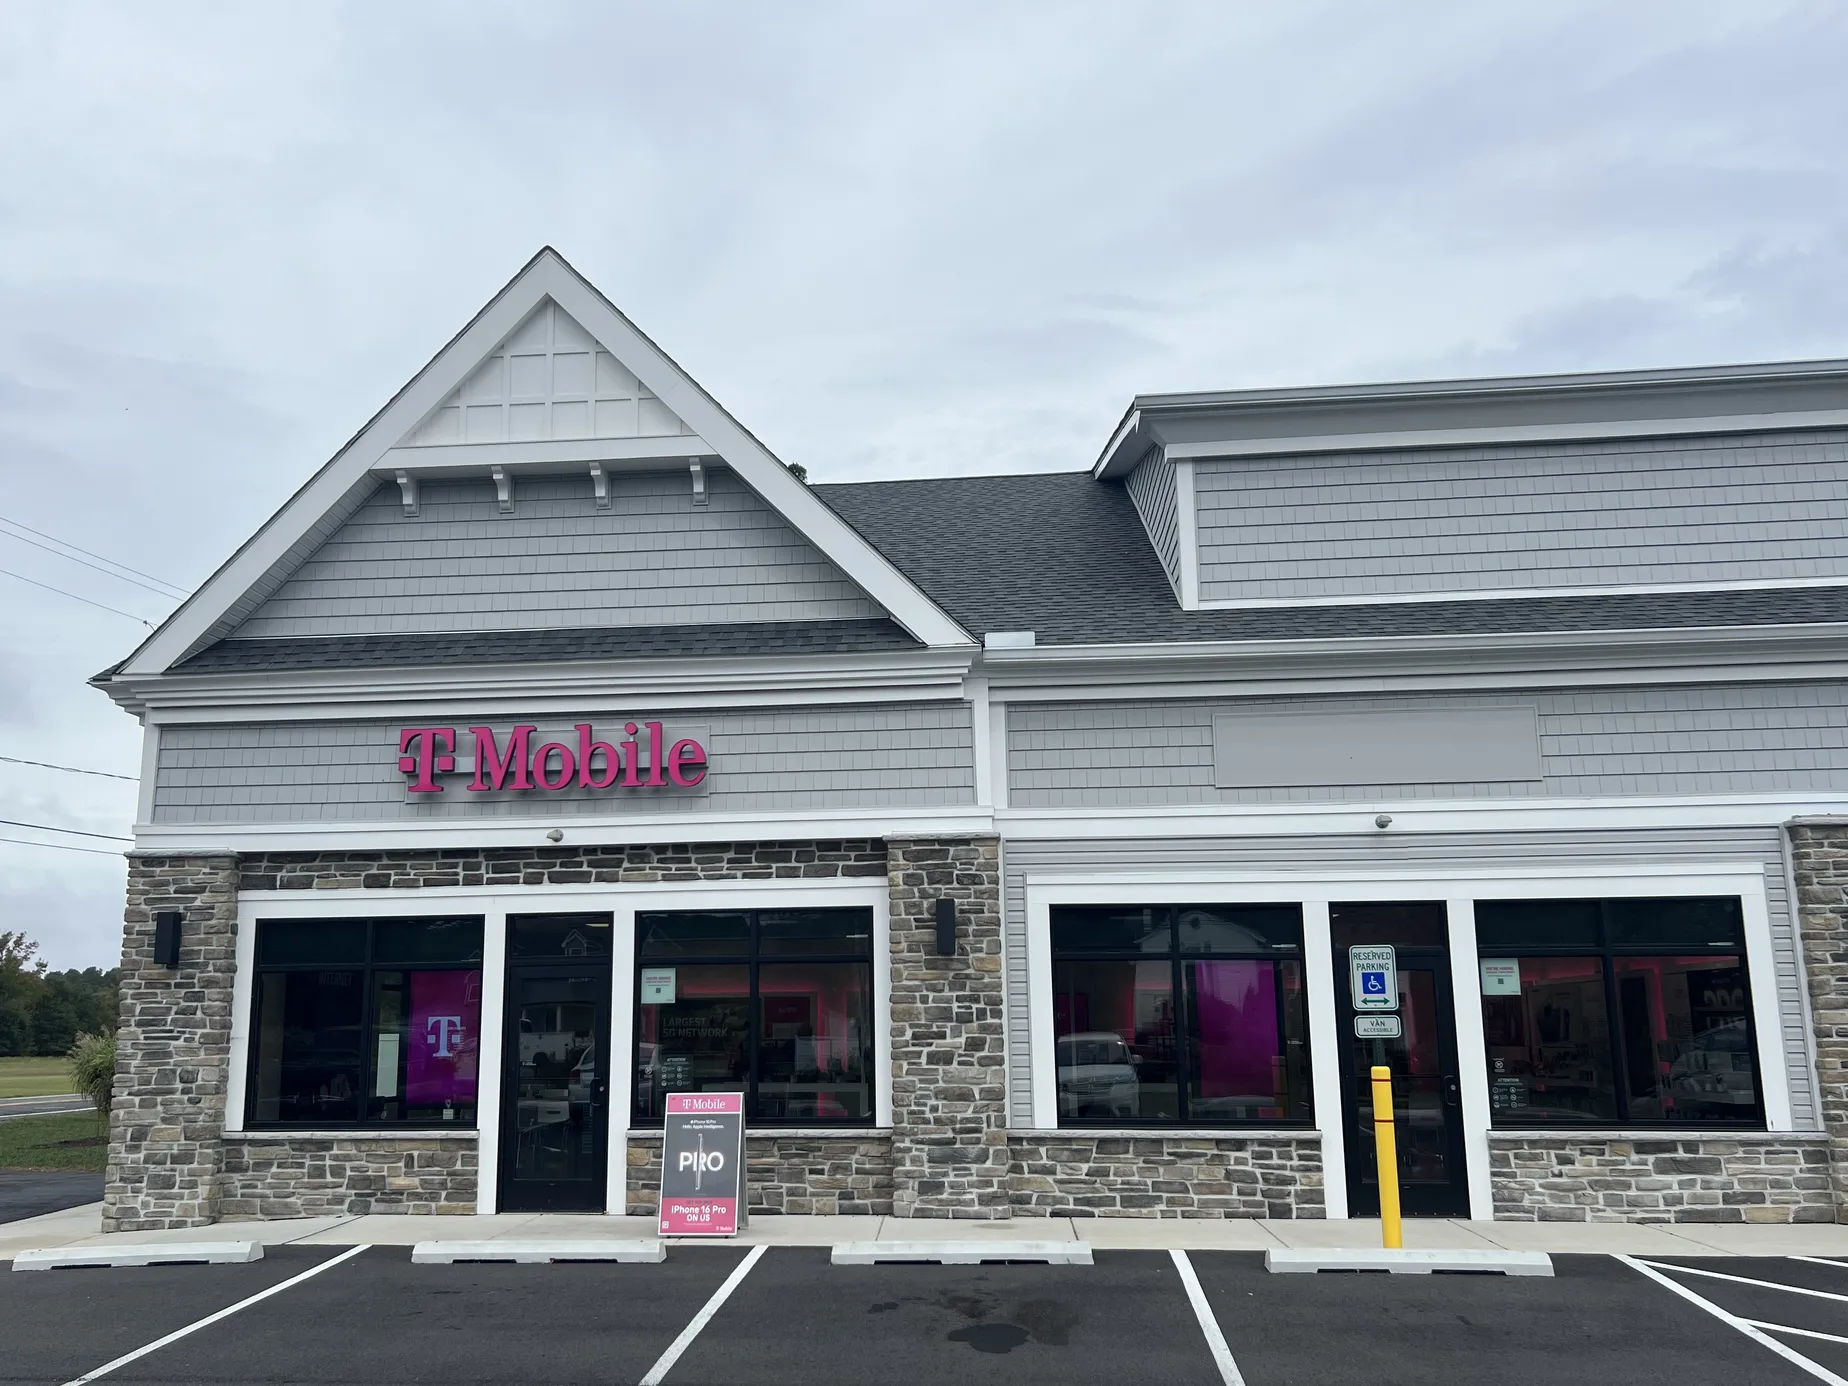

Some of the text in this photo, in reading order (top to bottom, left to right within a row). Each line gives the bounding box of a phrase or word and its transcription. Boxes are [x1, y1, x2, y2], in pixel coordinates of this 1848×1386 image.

[467, 721, 708, 791] Mobile
[1353, 951, 1391, 960] RESERVED
[1356, 962, 1390, 971] PARKING
[663, 1016, 708, 1027] LARGEST
[427, 1016, 461, 1057] T
[662, 1026, 728, 1037] 5G NETWORK
[693, 1098, 726, 1109] Mobile
[679, 1151, 724, 1172] PRO
[671, 1205, 727, 1214] iPhone 16 Pro
[686, 1213, 711, 1222] ON US
